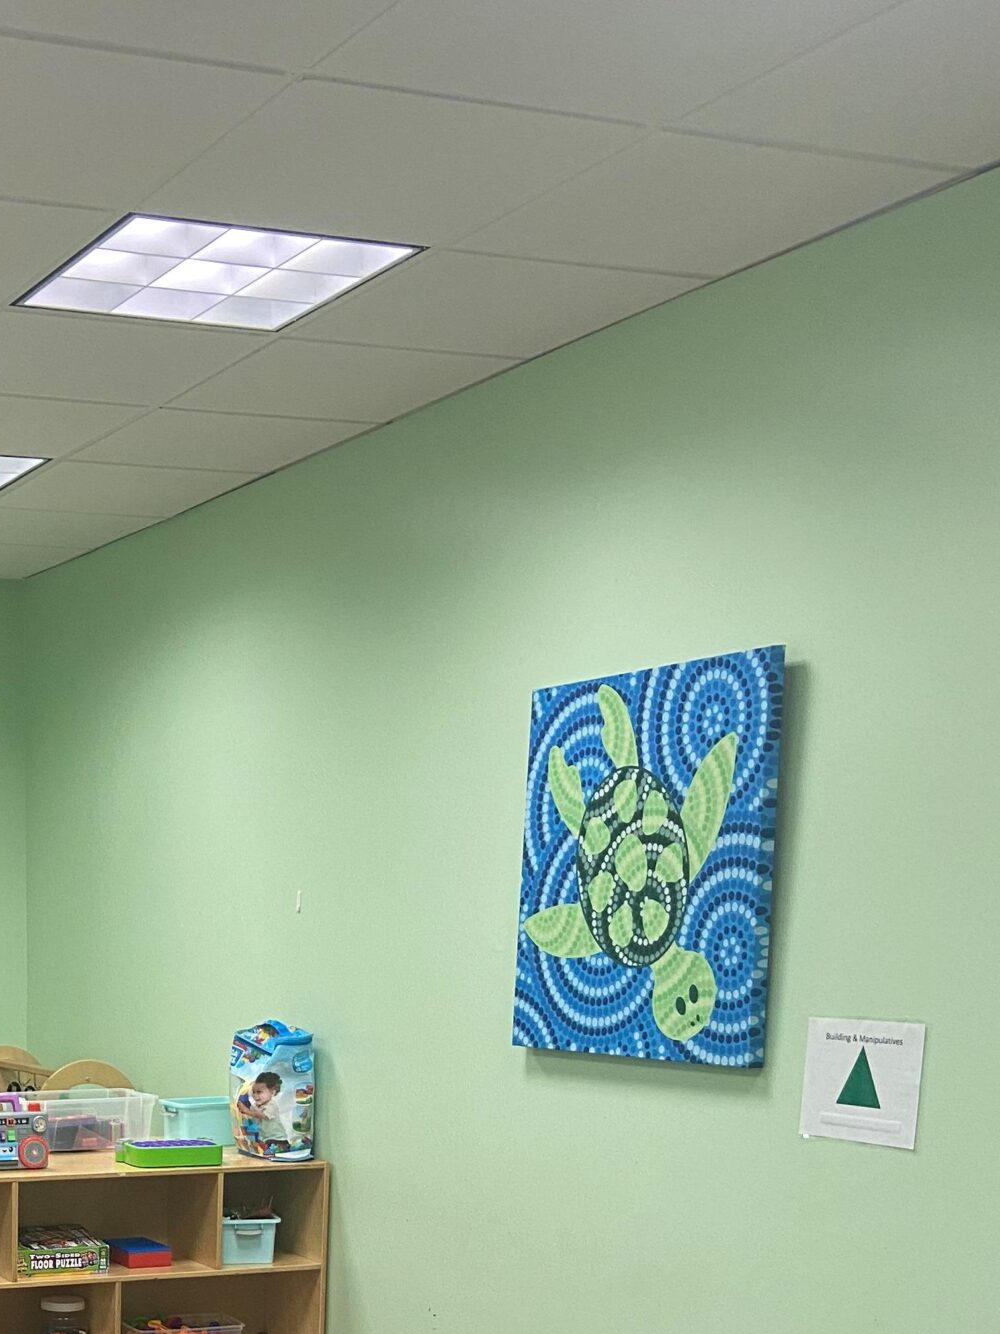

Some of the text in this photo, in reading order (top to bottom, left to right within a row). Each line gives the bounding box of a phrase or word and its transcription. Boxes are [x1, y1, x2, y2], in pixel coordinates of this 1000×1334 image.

[825, 1032, 904, 1046] Building & Manipulatives
[29, 1252, 81, 1260] TWO-SIDED
[30, 1257, 82, 1270] FLOOR PUZZLE
